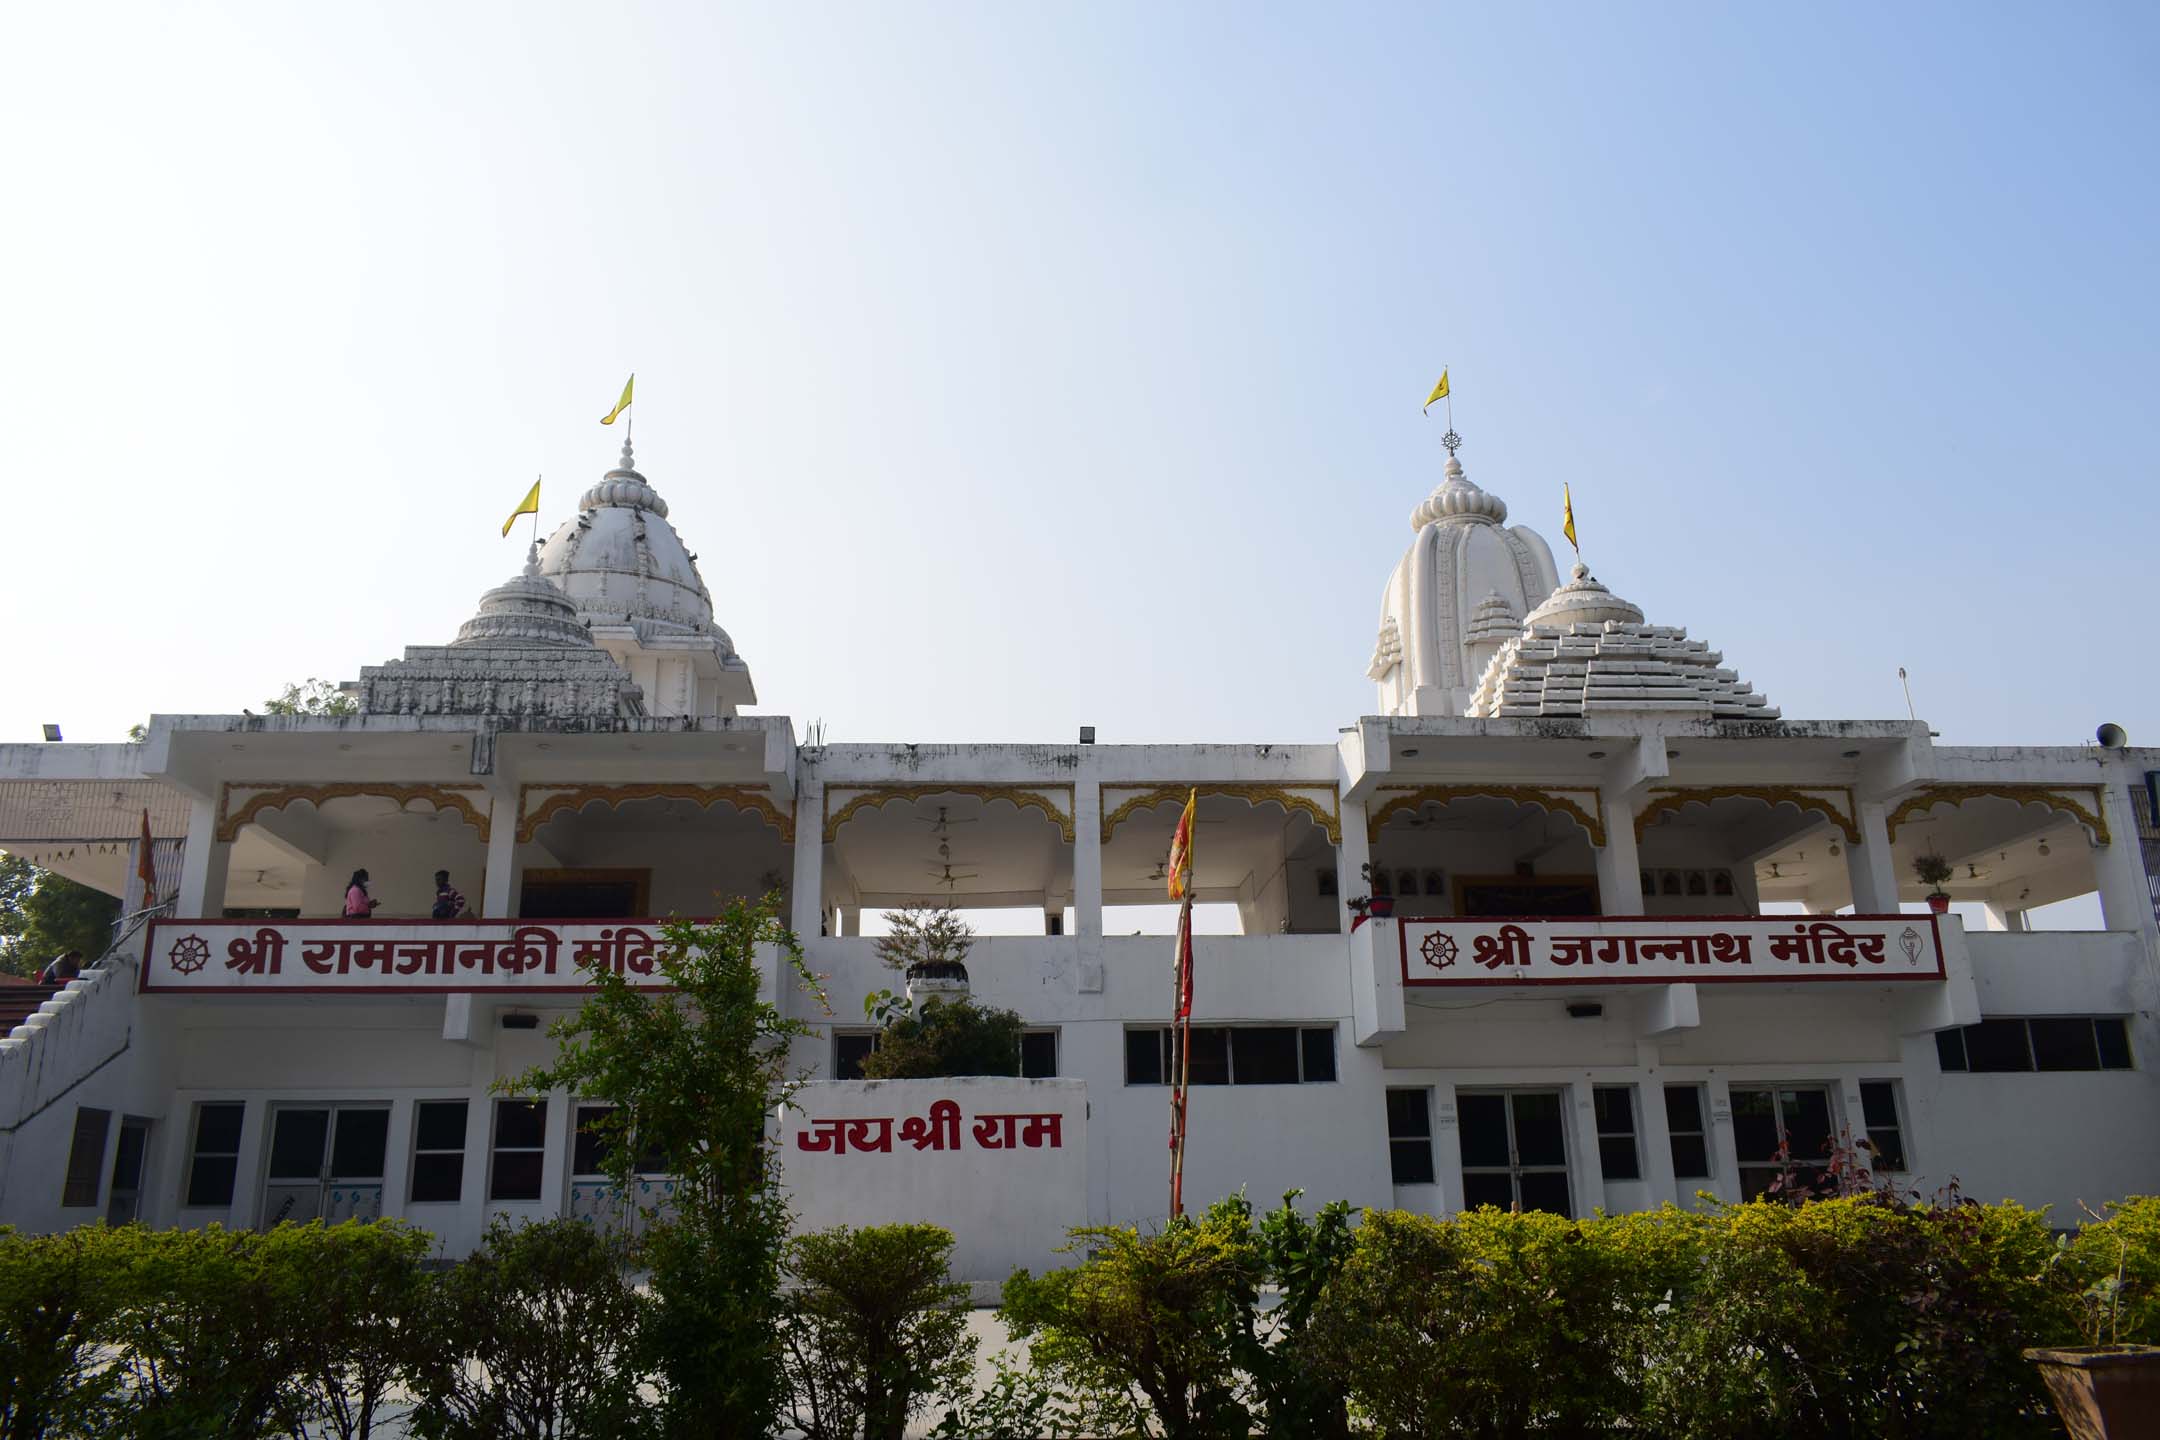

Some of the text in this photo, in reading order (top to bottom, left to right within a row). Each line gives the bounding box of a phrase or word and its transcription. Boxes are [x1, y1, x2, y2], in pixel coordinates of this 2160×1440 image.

[225, 928, 288, 975] श्री
[302, 927, 563, 975] रामजानकी
[1472, 923, 1886, 970] श्री जगन्नाथ मंदिर
[796, 1098, 1063, 1155] जय श्री राम
